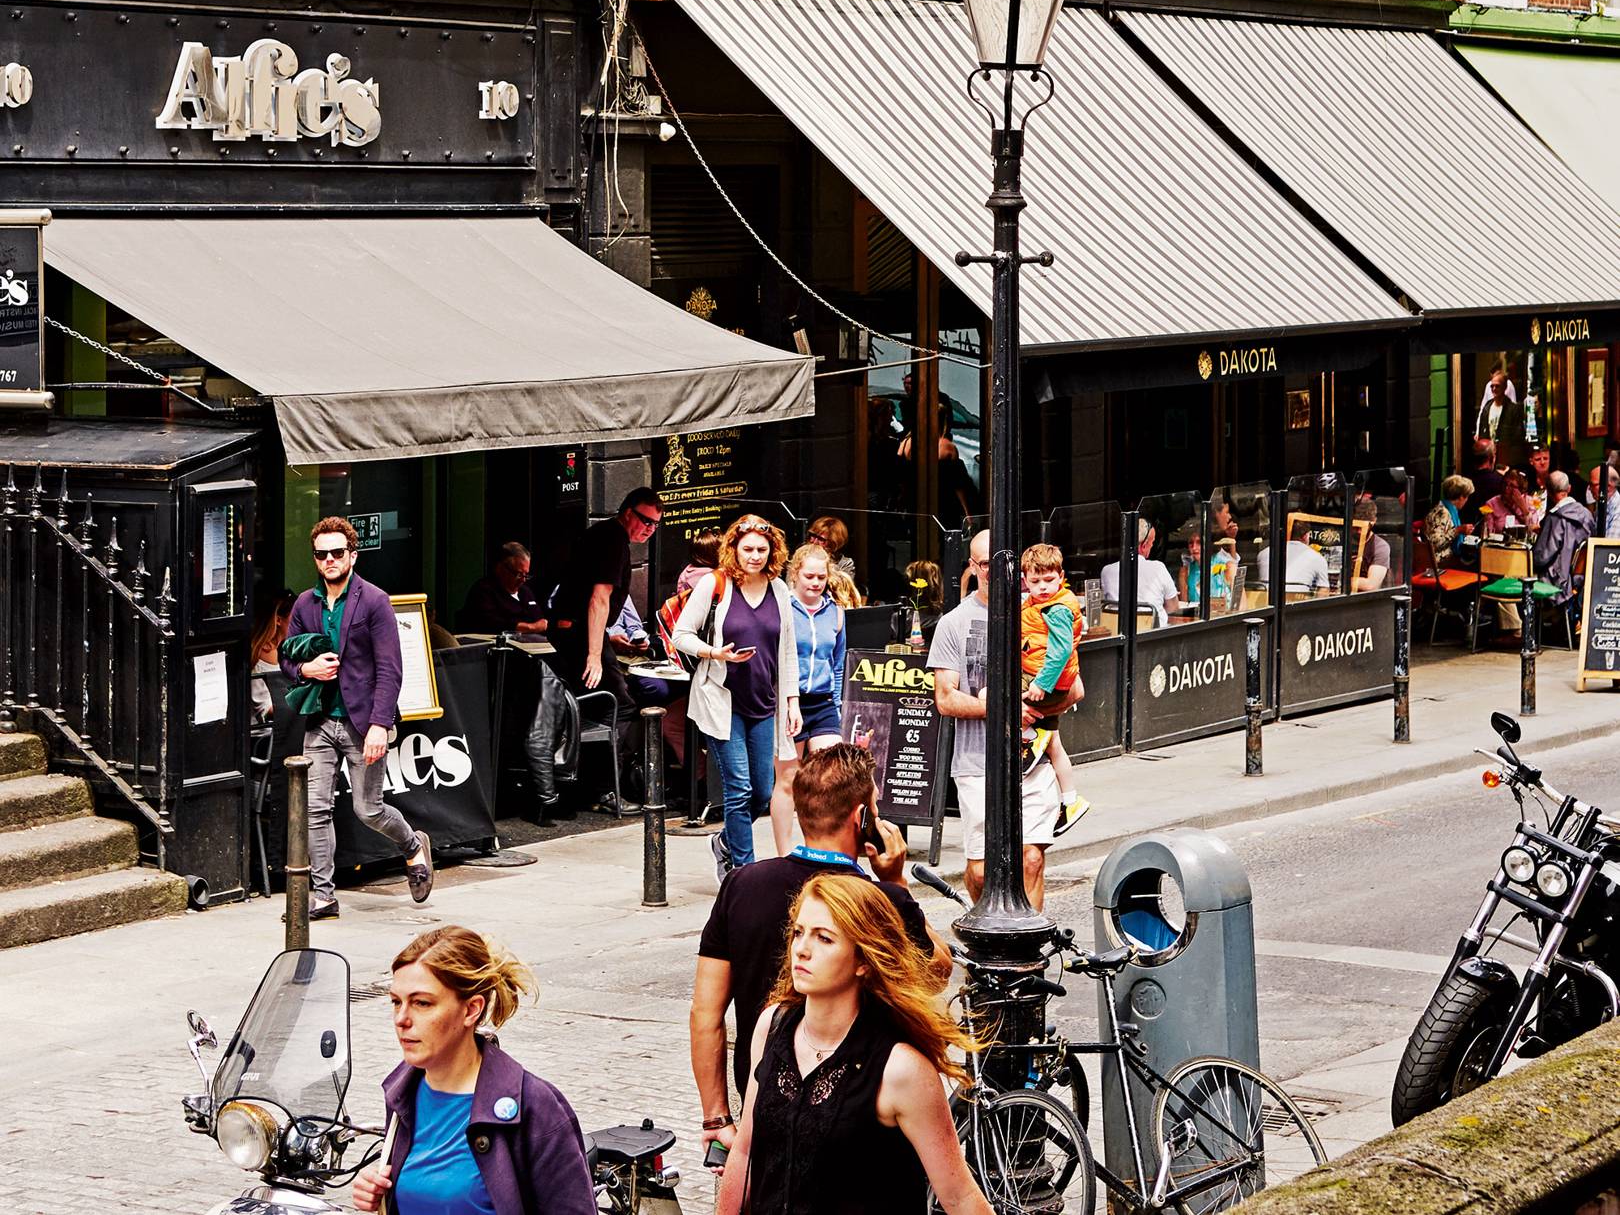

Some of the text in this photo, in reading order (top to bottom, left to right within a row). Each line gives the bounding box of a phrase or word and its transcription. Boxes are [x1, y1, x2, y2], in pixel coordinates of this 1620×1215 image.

[478, 80, 520, 120] 10
[1547, 318, 1590, 343] DAKOTA
[1220, 347, 1277, 376] DAKOTA
[562, 482, 579, 492] POST
[351, 518, 366, 527] Fire
[1315, 627, 1374, 662] DAKOTA
[849, 658, 935, 691] Alfies
[1169, 653, 1235, 693] DAKOTA
[897, 708, 925, 717] SUNDAY
[898, 718, 930, 727] MONDAY
[905, 729, 920, 743] €5
